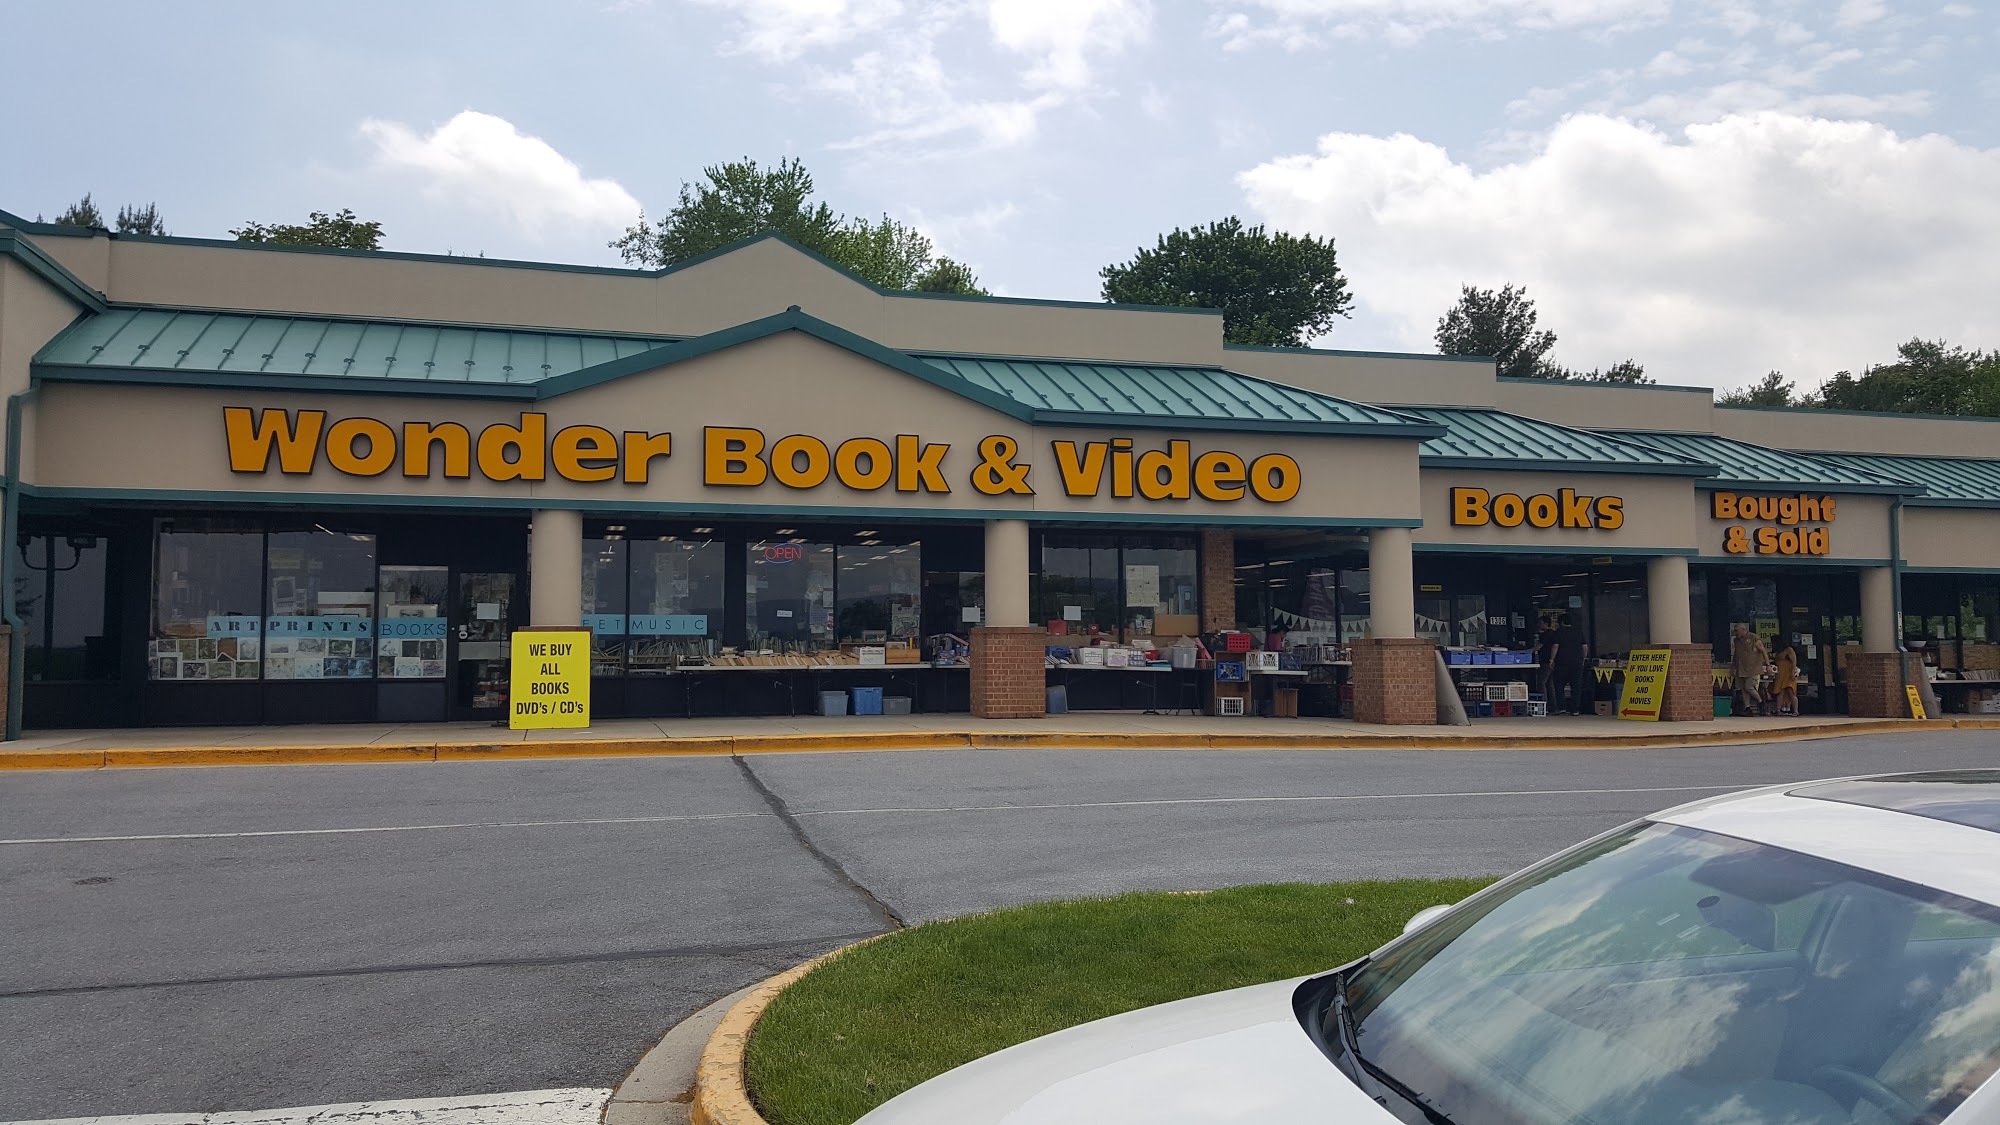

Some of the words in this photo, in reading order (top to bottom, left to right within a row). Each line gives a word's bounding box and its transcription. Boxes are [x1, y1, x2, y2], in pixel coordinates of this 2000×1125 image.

[222, 406, 672, 484] Wonder
[703, 426, 952, 494] Book
[970, 435, 1036, 495] &
[1051, 438, 1301, 502] Video
[1450, 486, 1624, 530] Books
[1711, 491, 1837, 525] Bought
[1722, 525, 1752, 554] &
[1754, 526, 1831, 556] Sold
[764, 546, 803, 560] OPEN
[210, 620, 260, 632] ART
[268, 620, 369, 633] PRINTS
[381, 623, 447, 636] BOOKS
[631, 619, 705, 630] MUSIC
[529, 643, 547, 657] WE
[550, 643, 572, 656] BUY
[1631, 653, 1650, 662] ENTER
[1650, 653, 1667, 662] HERE
[540, 663, 561, 675] ALL
[1629, 665, 1636, 673] IF
[1637, 665, 1648, 673] YOU
[1649, 664, 1664, 673] LOVE
[1634, 675, 1655, 683] BOOKS
[531, 682, 570, 695] BOOKS
[1635, 686, 1649, 694] AND
[1629, 697, 1652, 705] MOVIES
[516, 702, 548, 715] DVD's
[551, 701, 557, 714] /
[560, 701, 584, 714] CD's
